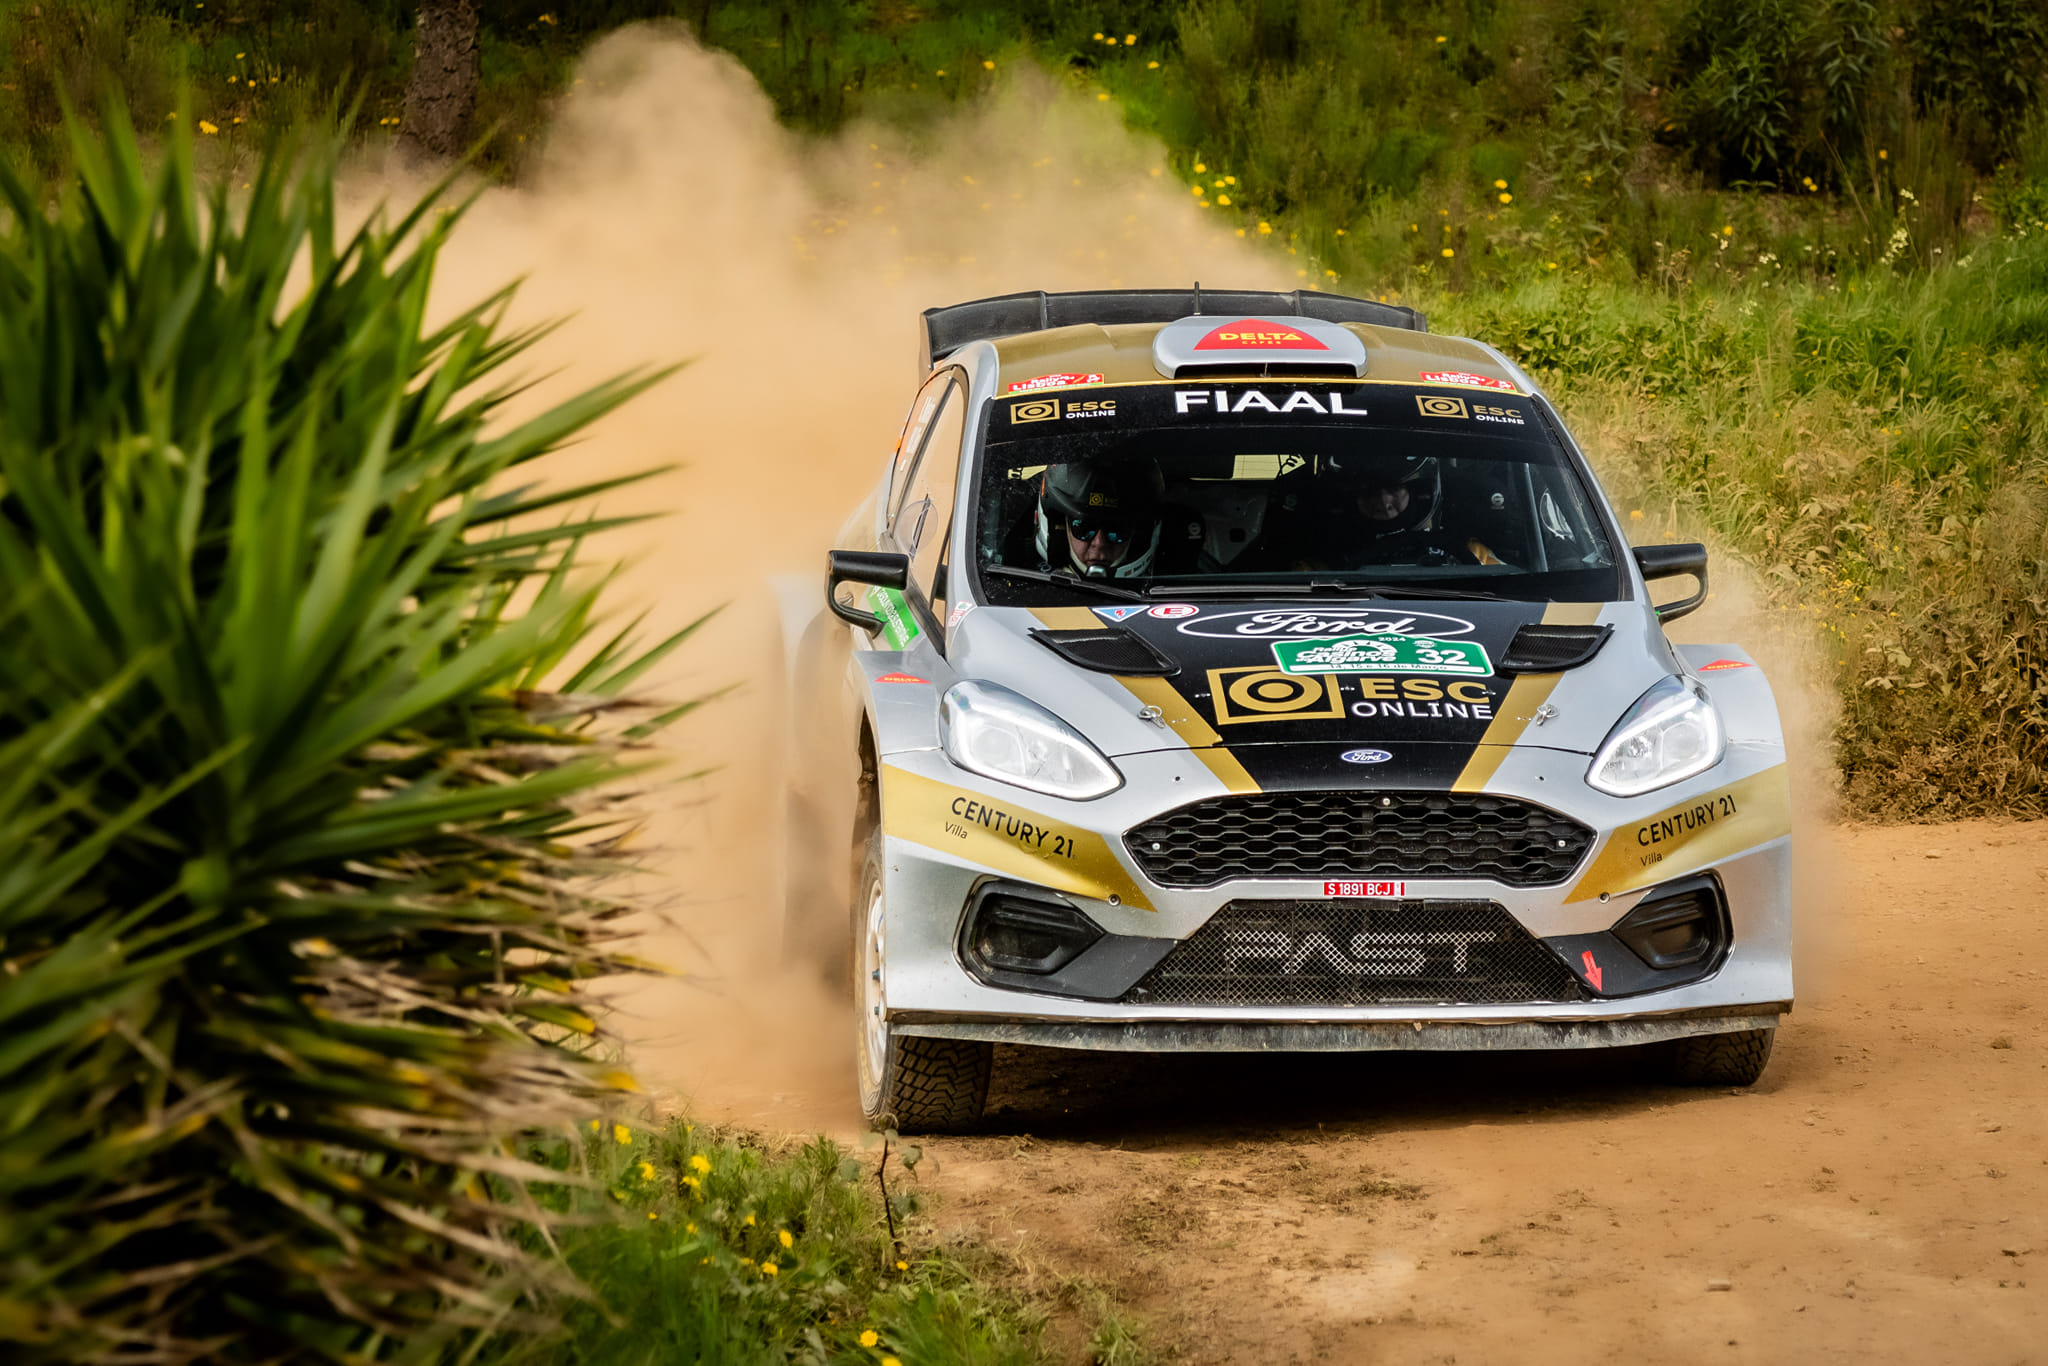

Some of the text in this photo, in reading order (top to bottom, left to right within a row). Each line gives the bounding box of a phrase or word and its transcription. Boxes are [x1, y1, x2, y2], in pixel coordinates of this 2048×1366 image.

[1219, 332, 1303, 341] DELTA
[1067, 400, 1117, 412] ESC
[1174, 390, 1368, 416] FIAAL
[1065, 409, 1117, 419] ONLINE
[1472, 404, 1522, 418] ESC
[1475, 414, 1525, 425] ONLINE
[1236, 612, 1417, 635] Ford
[1296, 650, 1396, 658] Casinos
[1306, 655, 1396, 664] Algarve
[1415, 648, 1470, 665] 32
[1360, 678, 1491, 703] ESC
[1351, 702, 1494, 720] ONLINE
[1351, 750, 1383, 761] Ford
[1638, 794, 1738, 846] CENTURY 21
[945, 821, 968, 840] Villa
[952, 797, 1074, 858] CENTURY 21
[1640, 852, 1663, 867] Villa
[1328, 883, 1391, 895] S 1891 BCJ
